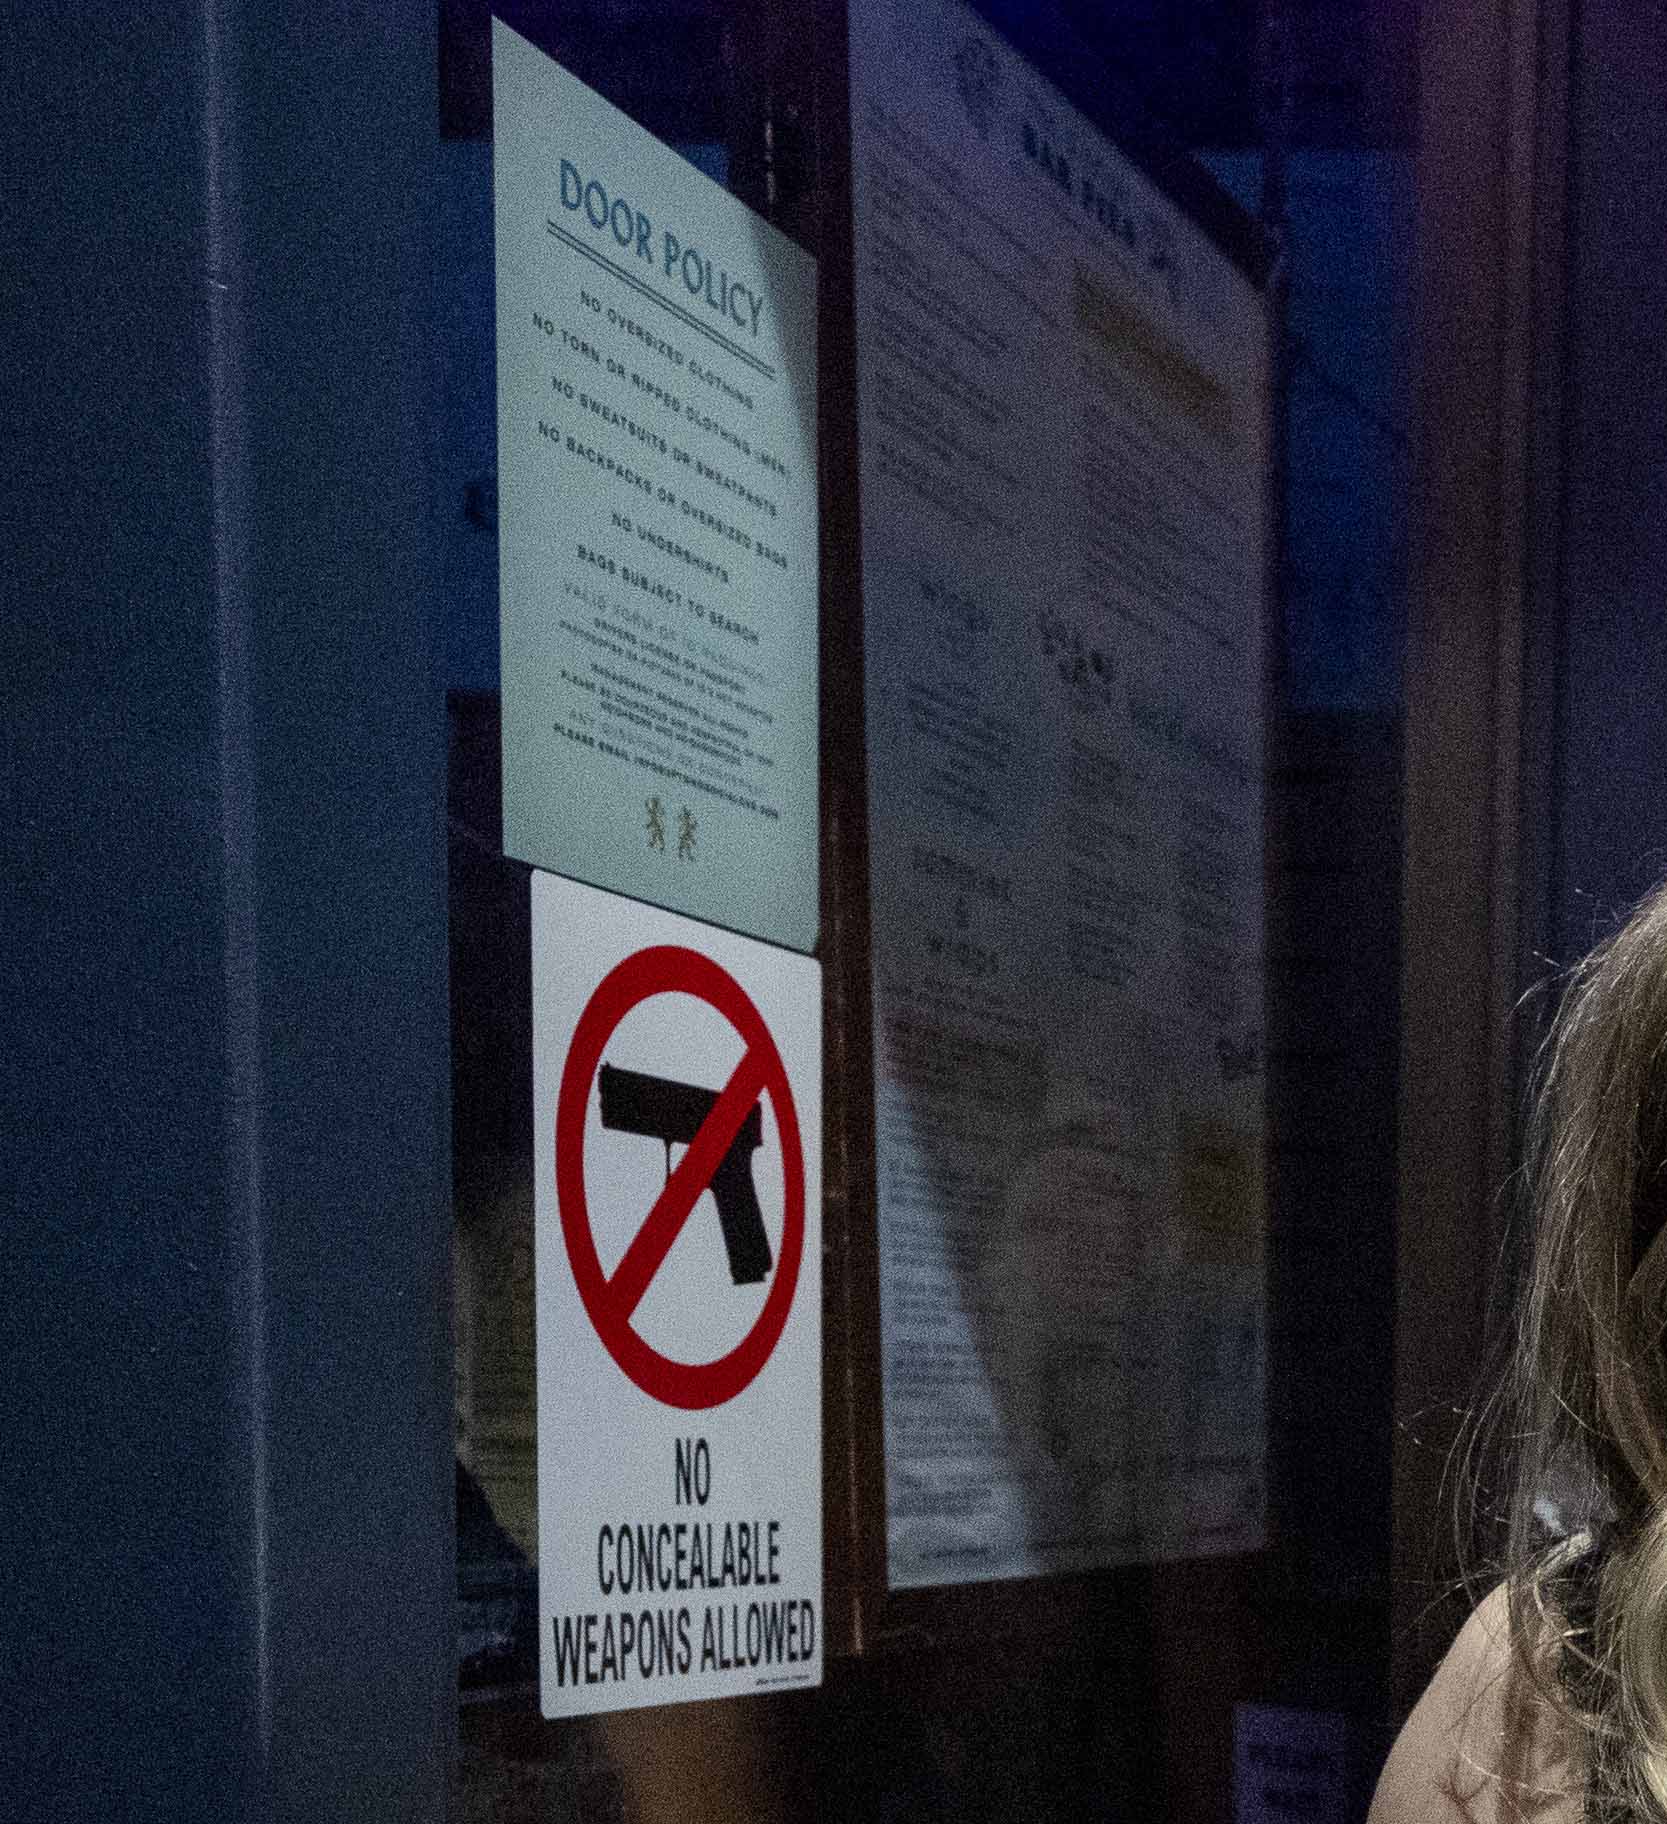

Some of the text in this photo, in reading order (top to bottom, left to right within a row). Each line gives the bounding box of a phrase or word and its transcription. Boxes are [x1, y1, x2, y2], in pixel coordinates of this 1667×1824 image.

[559, 158, 652, 263] DOOR
[664, 231, 762, 337] POLICY
[532, 312, 554, 338] NO
[561, 329, 599, 365] TORN
[606, 357, 625, 380] OR
[632, 372, 680, 413] RIPPED
[686, 405, 750, 455] CLOTHING
[580, 290, 753, 409] NO OVERSIZED CLOTHING
[538, 421, 787, 567] NO BACKPACKS OR OVERSIZED BAGS
[552, 377, 777, 516] NO SWEATSUITS OR SWEATPANTS
[577, 545, 759, 645] BAGS SUBJECT TO SEARCH
[612, 512, 728, 583] NO UNDERSHIRTS
[552, 722, 595, 748] PLEASE
[674, 1437, 711, 1506] NO
[598, 1521, 780, 1596] CONCEALABLE
[552, 1599, 816, 1688] WEAPONS ALLOWED
